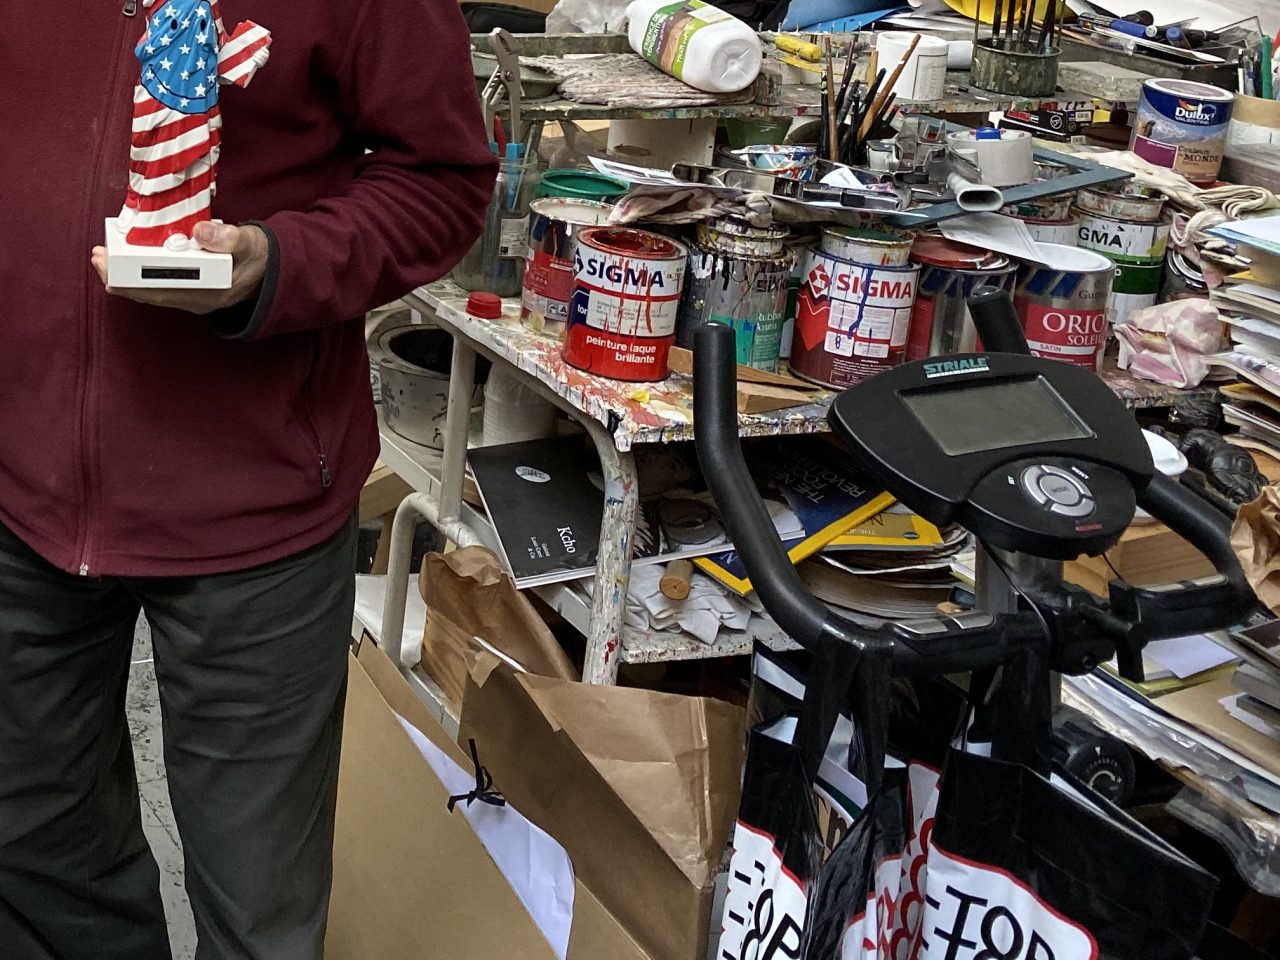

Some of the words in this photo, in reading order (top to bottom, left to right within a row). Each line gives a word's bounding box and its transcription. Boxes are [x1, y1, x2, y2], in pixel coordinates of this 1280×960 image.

[1175, 103, 1211, 120] Dulux
[1175, 116, 1210, 125] VALENTINE
[1184, 153, 1220, 163] MONDE
[1078, 227, 1123, 249] GMA
[586, 258, 665, 288] SIGMA
[836, 273, 912, 299] SIGMA
[586, 334, 628, 352] peinture
[630, 342, 657, 355] laque
[1040, 343, 1062, 352] SATIN
[615, 352, 656, 364] brillante
[923, 356, 987, 374] STRIALE
[556, 526, 577, 553] Kcho
